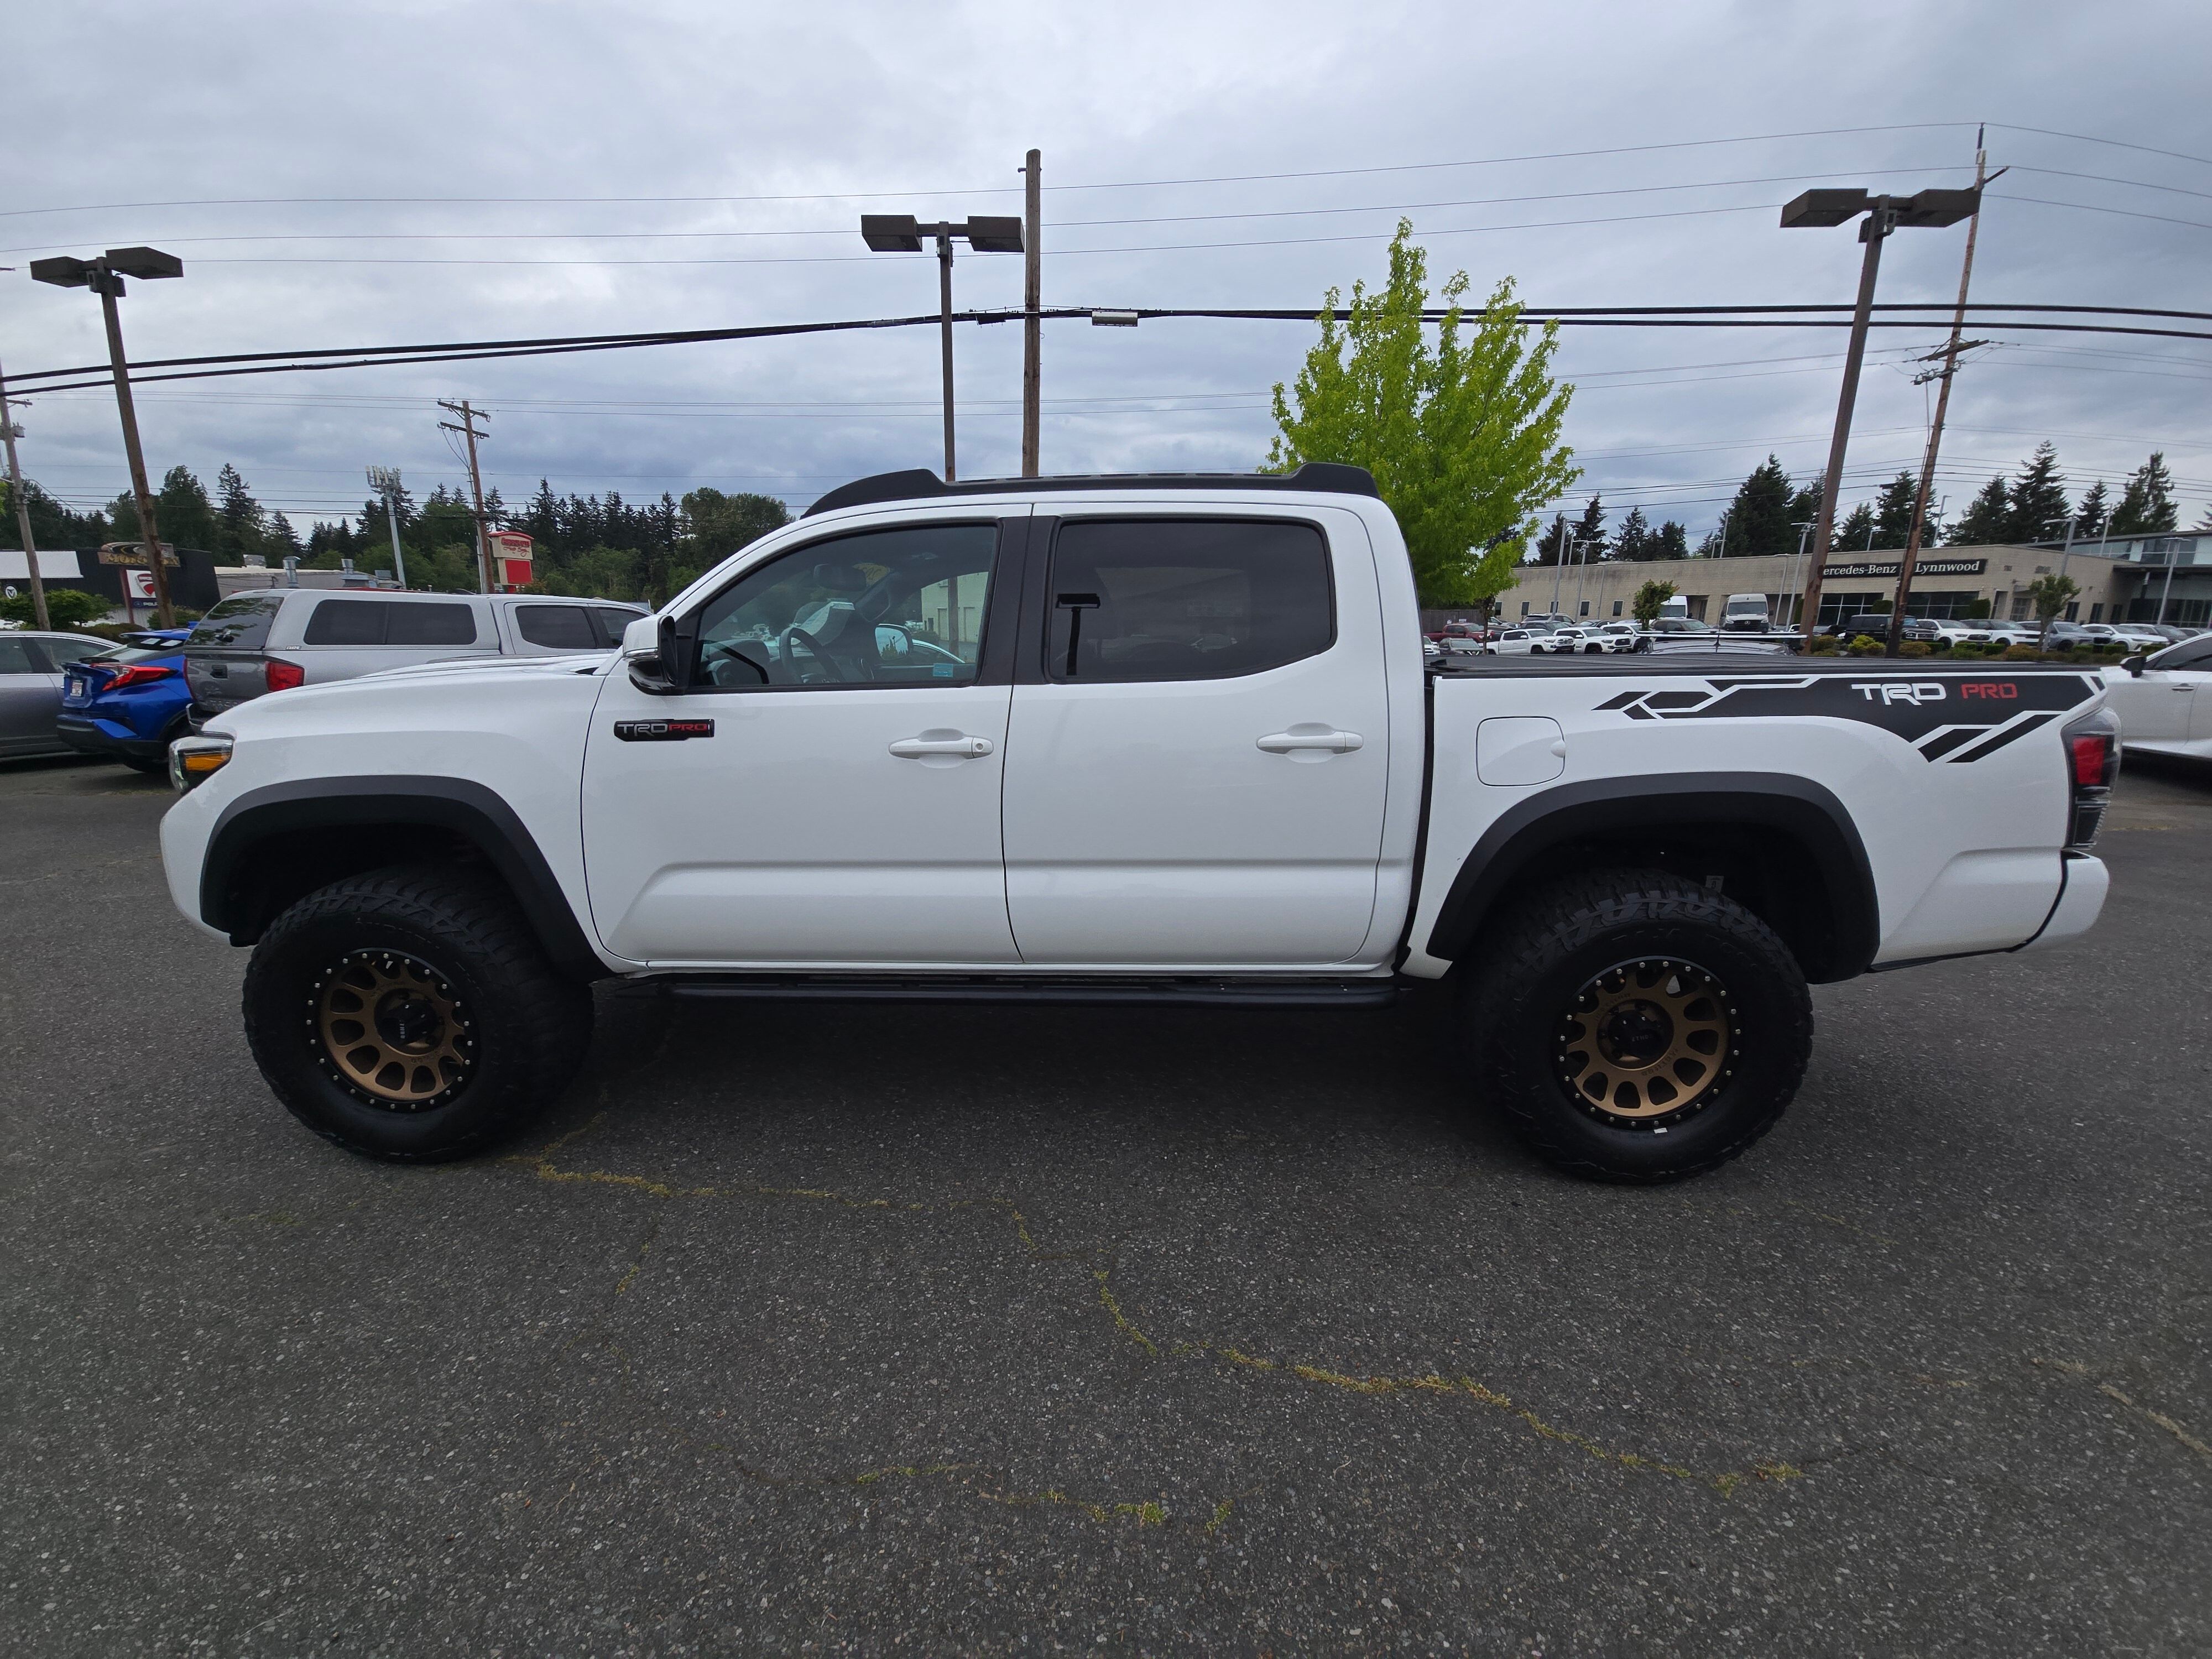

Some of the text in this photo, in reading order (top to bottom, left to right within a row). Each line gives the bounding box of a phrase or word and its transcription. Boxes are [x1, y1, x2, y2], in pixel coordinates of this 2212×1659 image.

[1823, 565, 1896, 575] ercedes-Benz
[1915, 561, 1979, 575] Lynnwood
[1851, 683, 2018, 706] TRD PRO
[617, 723, 668, 737] TRD
